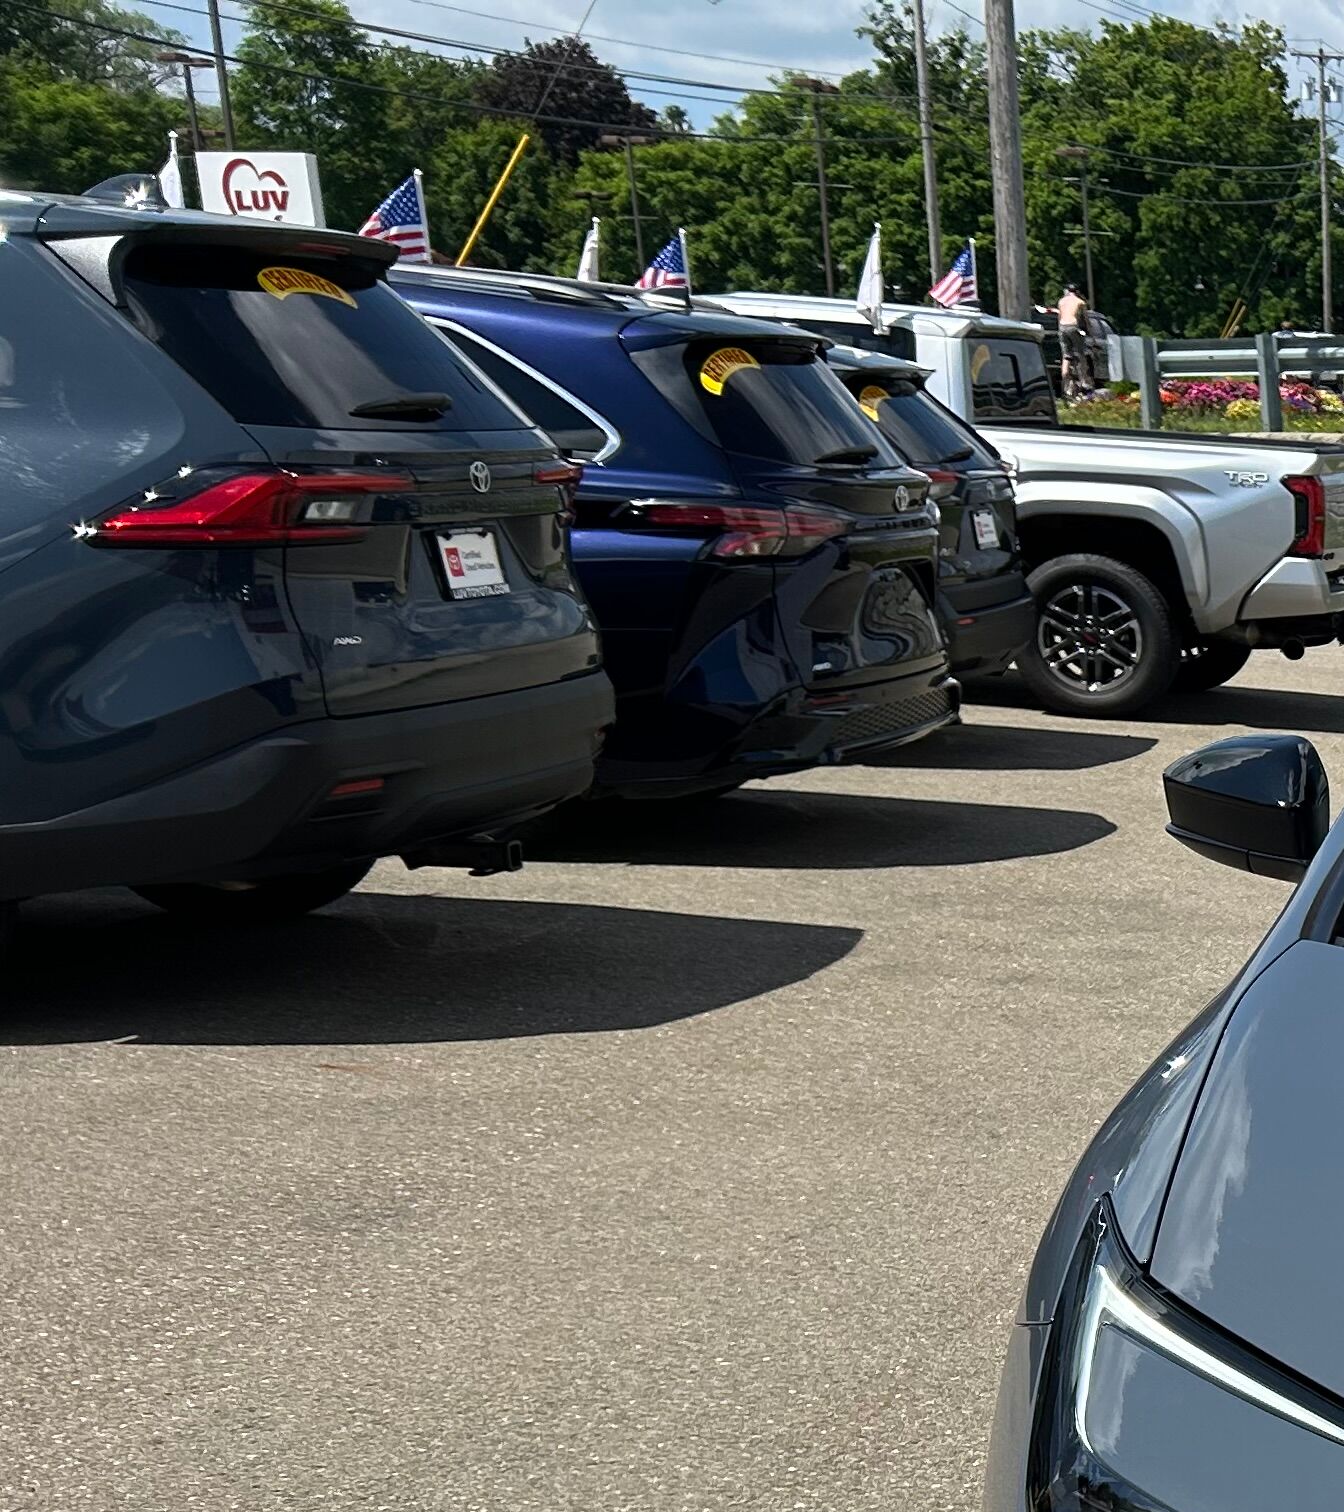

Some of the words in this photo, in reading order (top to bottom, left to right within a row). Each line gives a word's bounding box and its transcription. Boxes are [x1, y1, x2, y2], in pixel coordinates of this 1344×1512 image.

[234, 190, 289, 212] LUV
[1223, 470, 1269, 485] TRD
[333, 635, 362, 646] AWD
